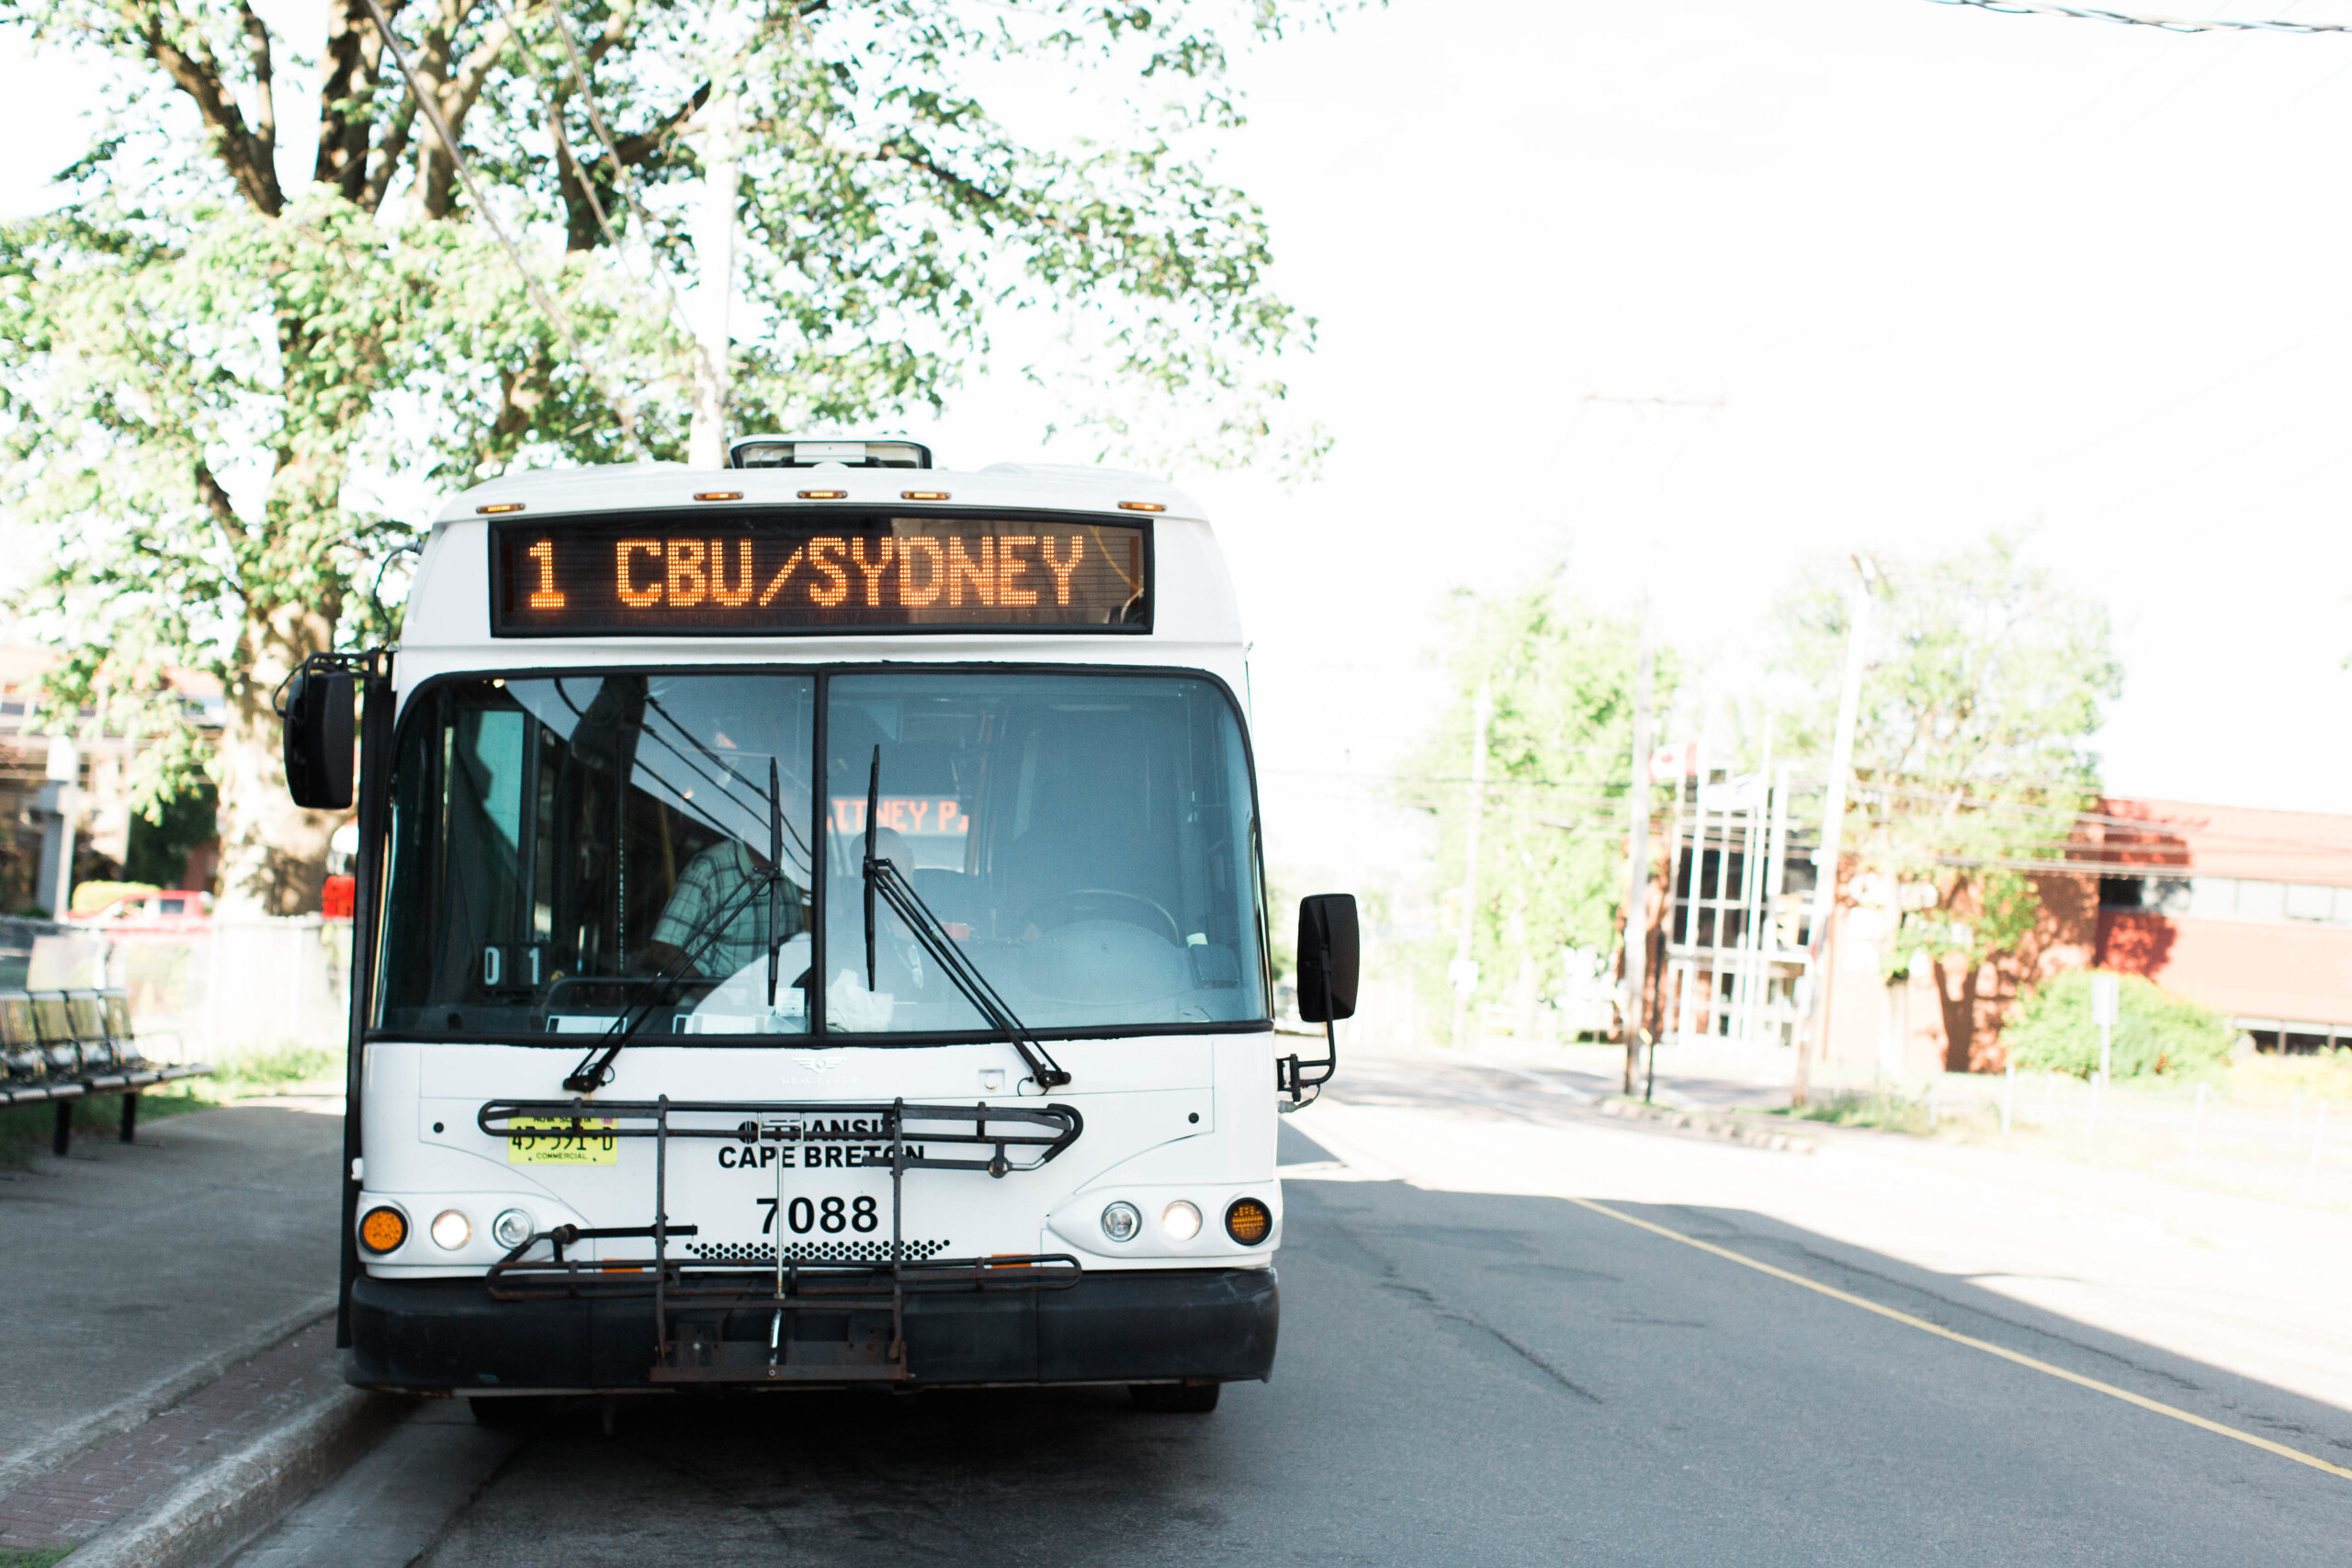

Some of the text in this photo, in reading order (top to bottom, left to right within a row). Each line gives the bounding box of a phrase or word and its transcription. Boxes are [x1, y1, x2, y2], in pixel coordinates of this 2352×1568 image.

[529, 536, 1084, 608] 1 CBU/SYDNEY
[828, 798, 929, 832] ITNEY
[536, 1152, 588, 1160] COMMERCIAL
[718, 1145, 796, 1168] CAPE
[756, 1196, 878, 1235] 7088
